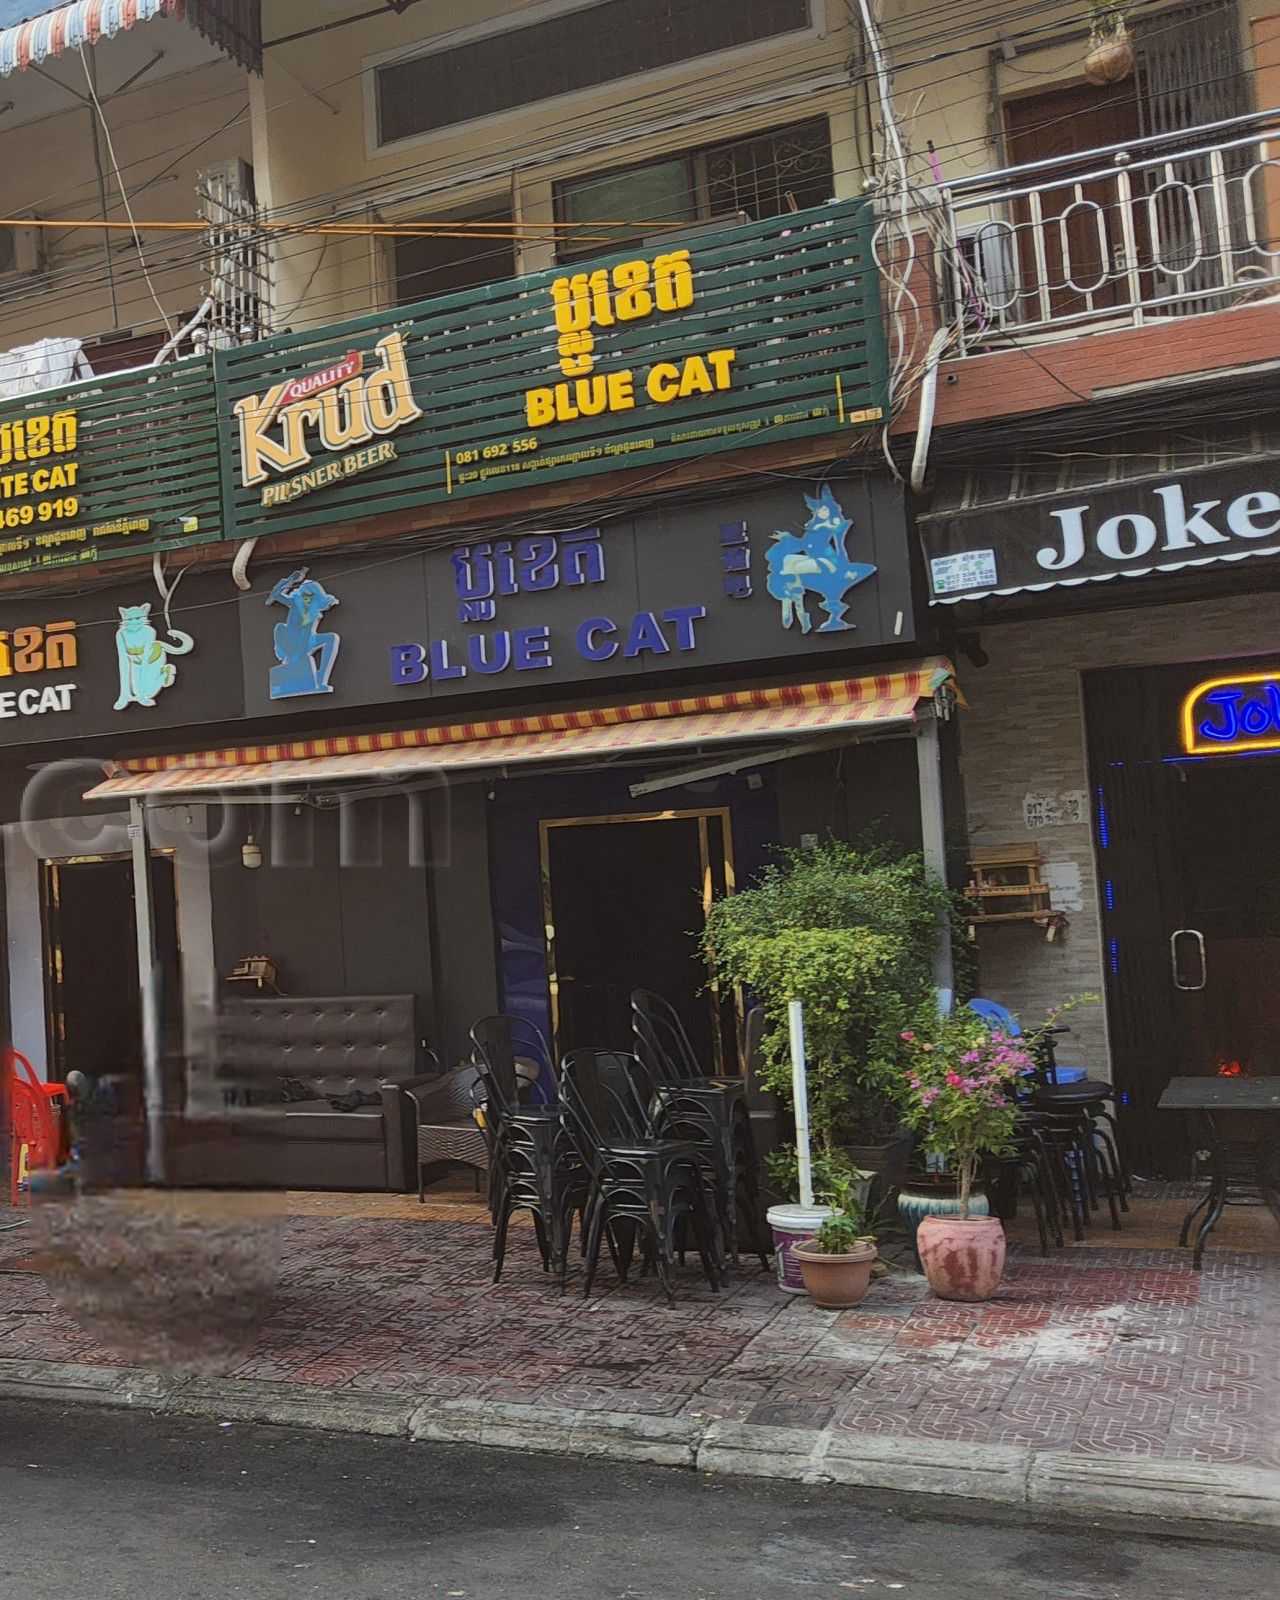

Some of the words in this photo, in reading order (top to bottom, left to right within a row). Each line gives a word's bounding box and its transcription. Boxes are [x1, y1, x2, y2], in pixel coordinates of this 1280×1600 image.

[233, 330, 423, 489] Krud
[289, 360, 356, 400] QUALITY
[526, 371, 635, 427] BLUE
[646, 349, 736, 403] CAT
[33, 463, 79, 493] CAT
[260, 459, 342, 507] PILSNER
[343, 440, 397, 478] BEER
[456, 449, 479, 465] 081
[482, 444, 508, 459] 692
[513, 437, 538, 454] 556
[38, 498, 79, 522] 919
[1036, 484, 1280, 570] Joke
[390, 626, 553, 686] BLUE
[576, 605, 706, 662] CAT
[18, 684, 77, 715] CAT
[1199, 682, 1280, 741] Jo
